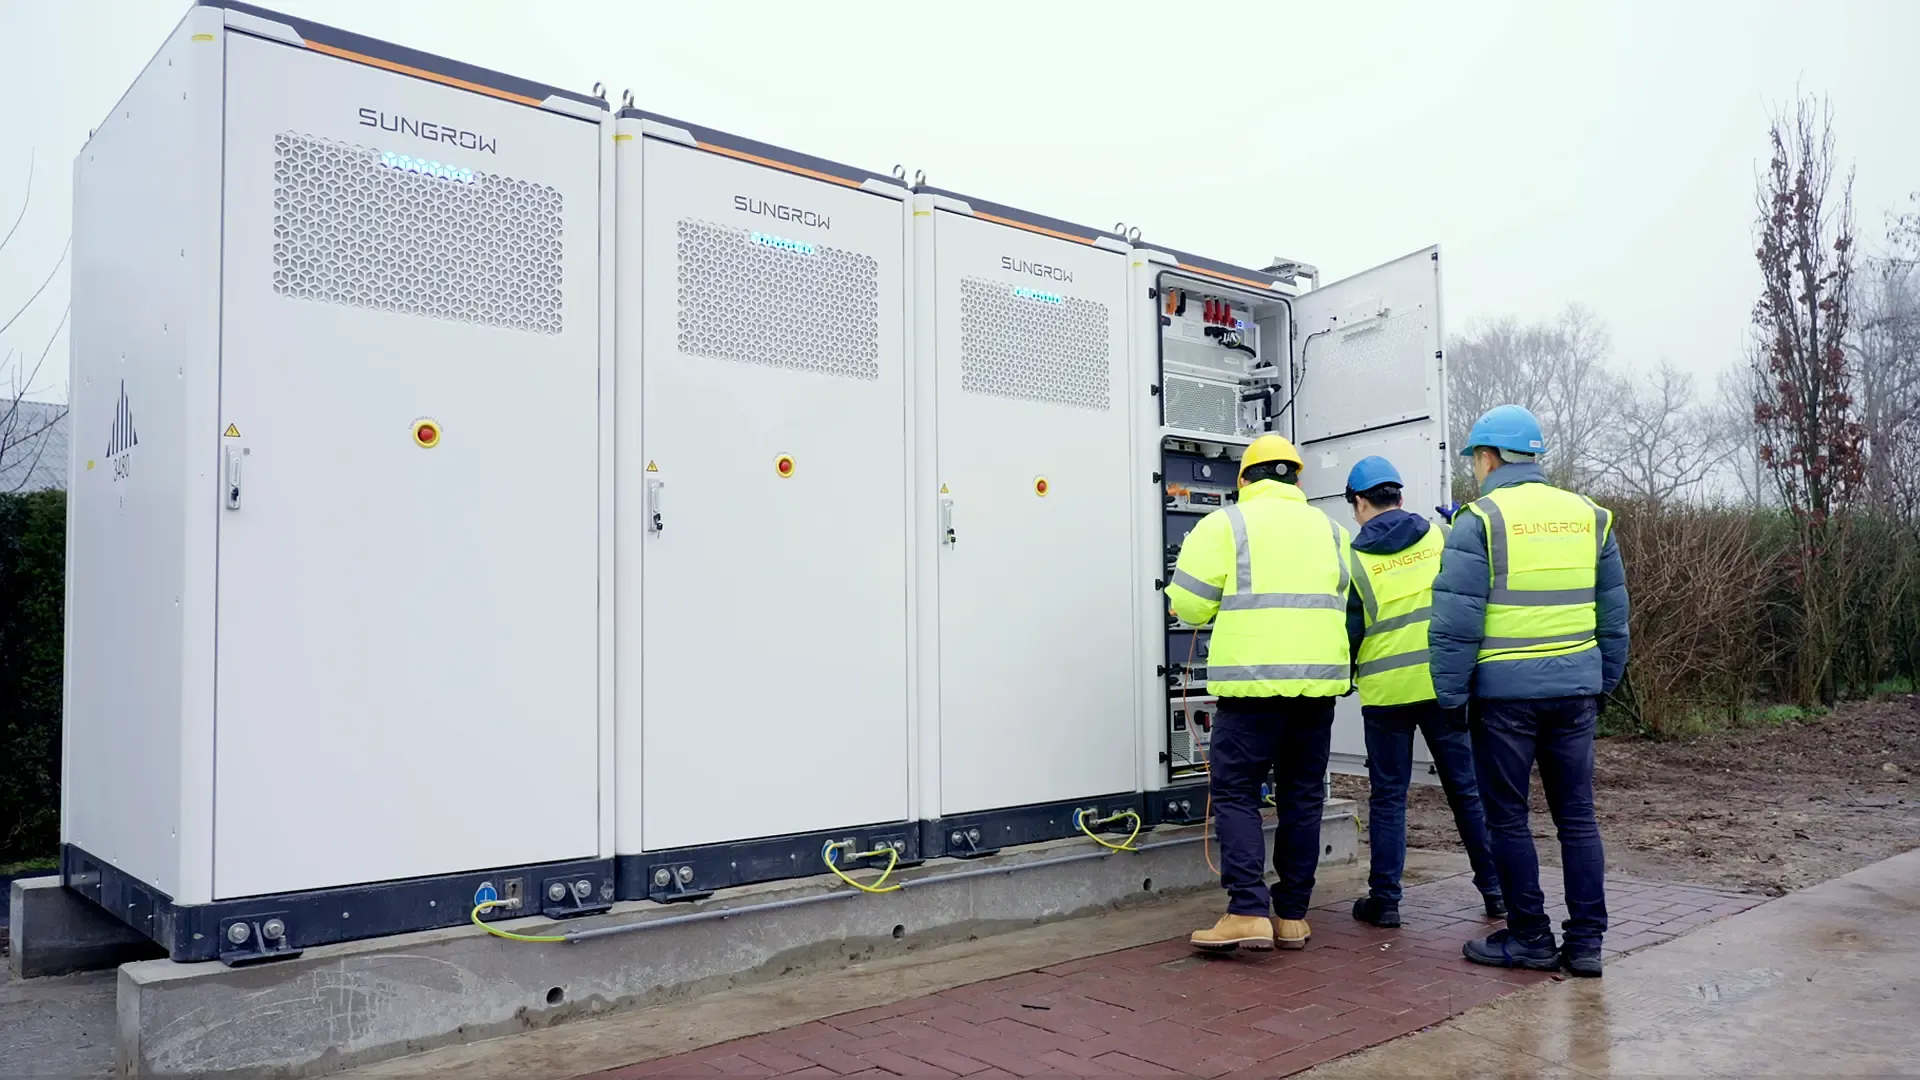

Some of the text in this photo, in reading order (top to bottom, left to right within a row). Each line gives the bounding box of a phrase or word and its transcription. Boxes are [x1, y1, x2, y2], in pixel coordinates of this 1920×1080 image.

[359, 108, 496, 155] SUNGROW
[734, 195, 830, 230] SUNGROW
[1001, 256, 1073, 283] SUNGROW
[1512, 522, 1590, 535] SUNGROW
